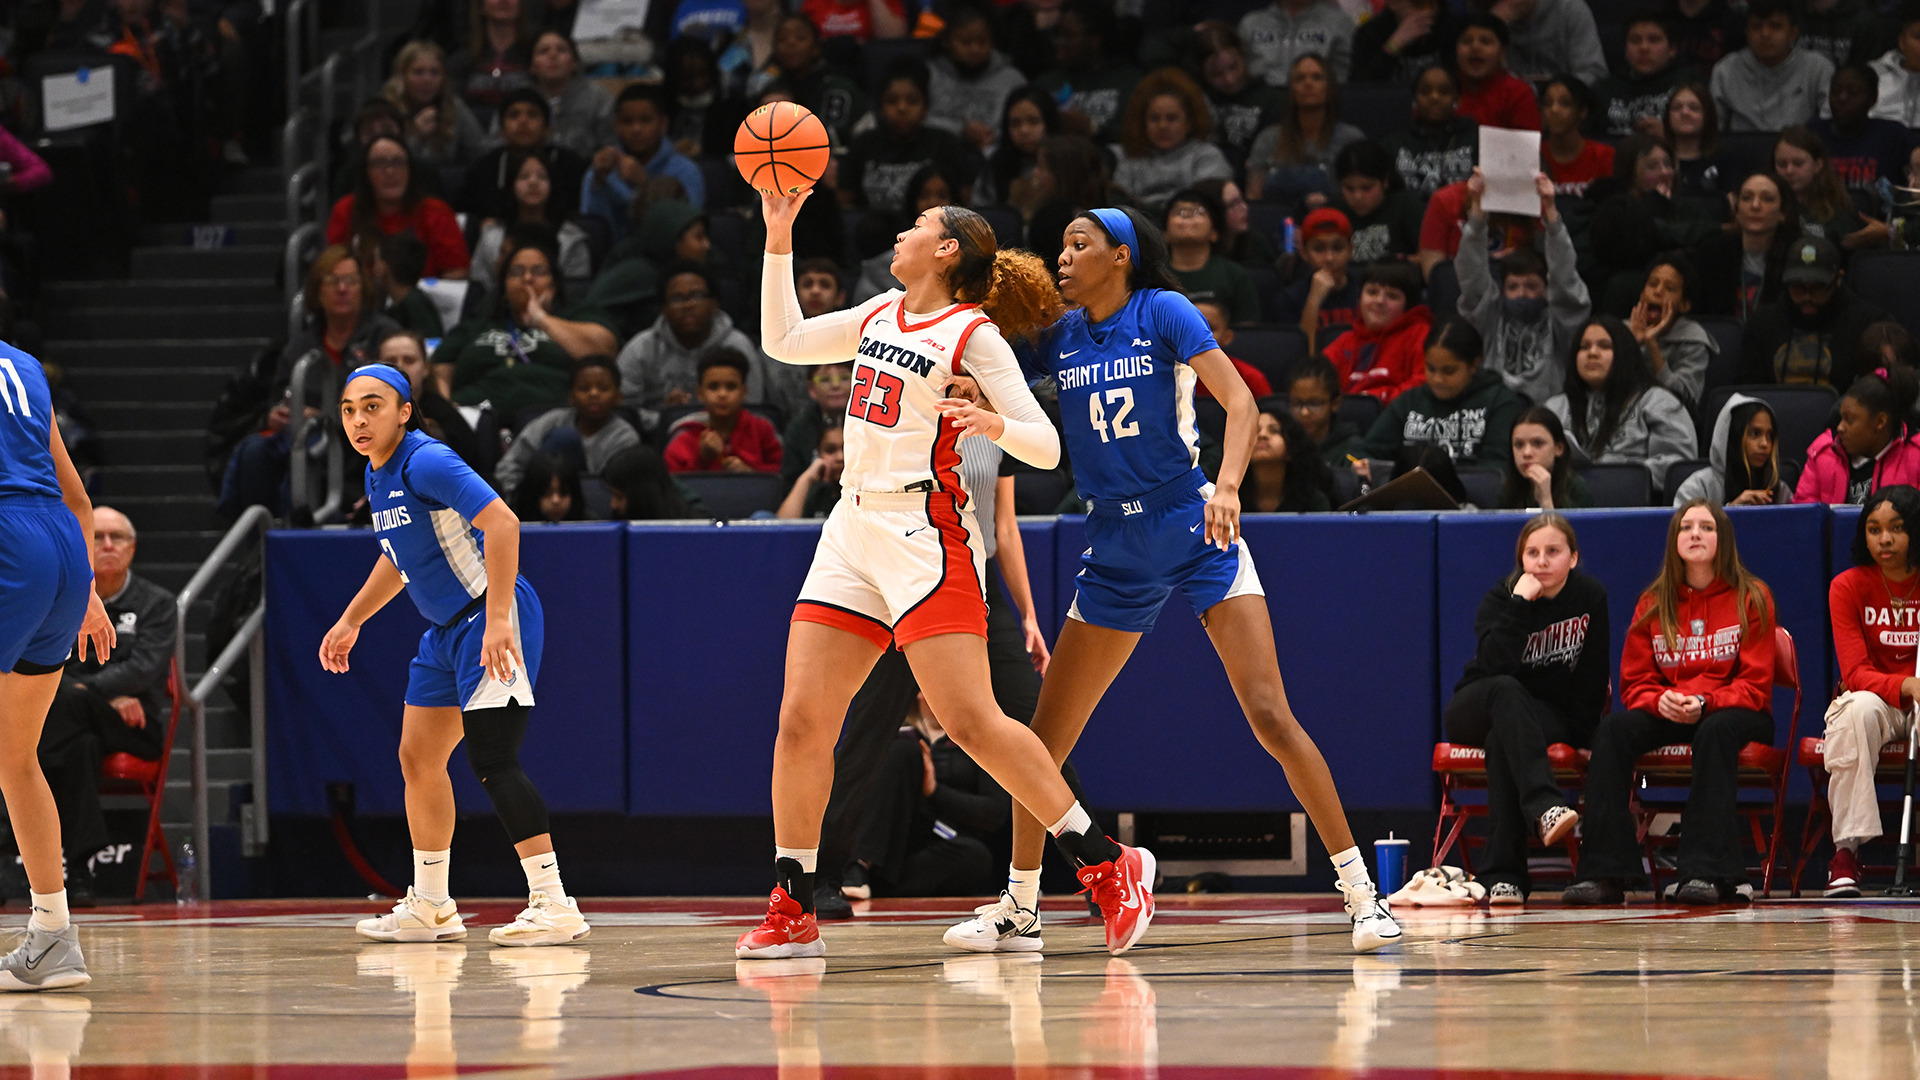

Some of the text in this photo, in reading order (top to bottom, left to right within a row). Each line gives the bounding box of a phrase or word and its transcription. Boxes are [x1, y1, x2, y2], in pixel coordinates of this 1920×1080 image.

[858, 336, 936, 378] DAYTON
[1058, 354, 1154, 390] SAINT LOUIS
[848, 364, 905, 428] 23
[1089, 387, 1140, 443] 42
[380, 505, 412, 531] LOUIS
[1121, 500, 1143, 516] SLU
[380, 538, 410, 583] 2
[1865, 606, 1920, 627] DAYT
[1521, 613, 1590, 664] ANTHERS
[1450, 748, 1486, 759] DAYTO
